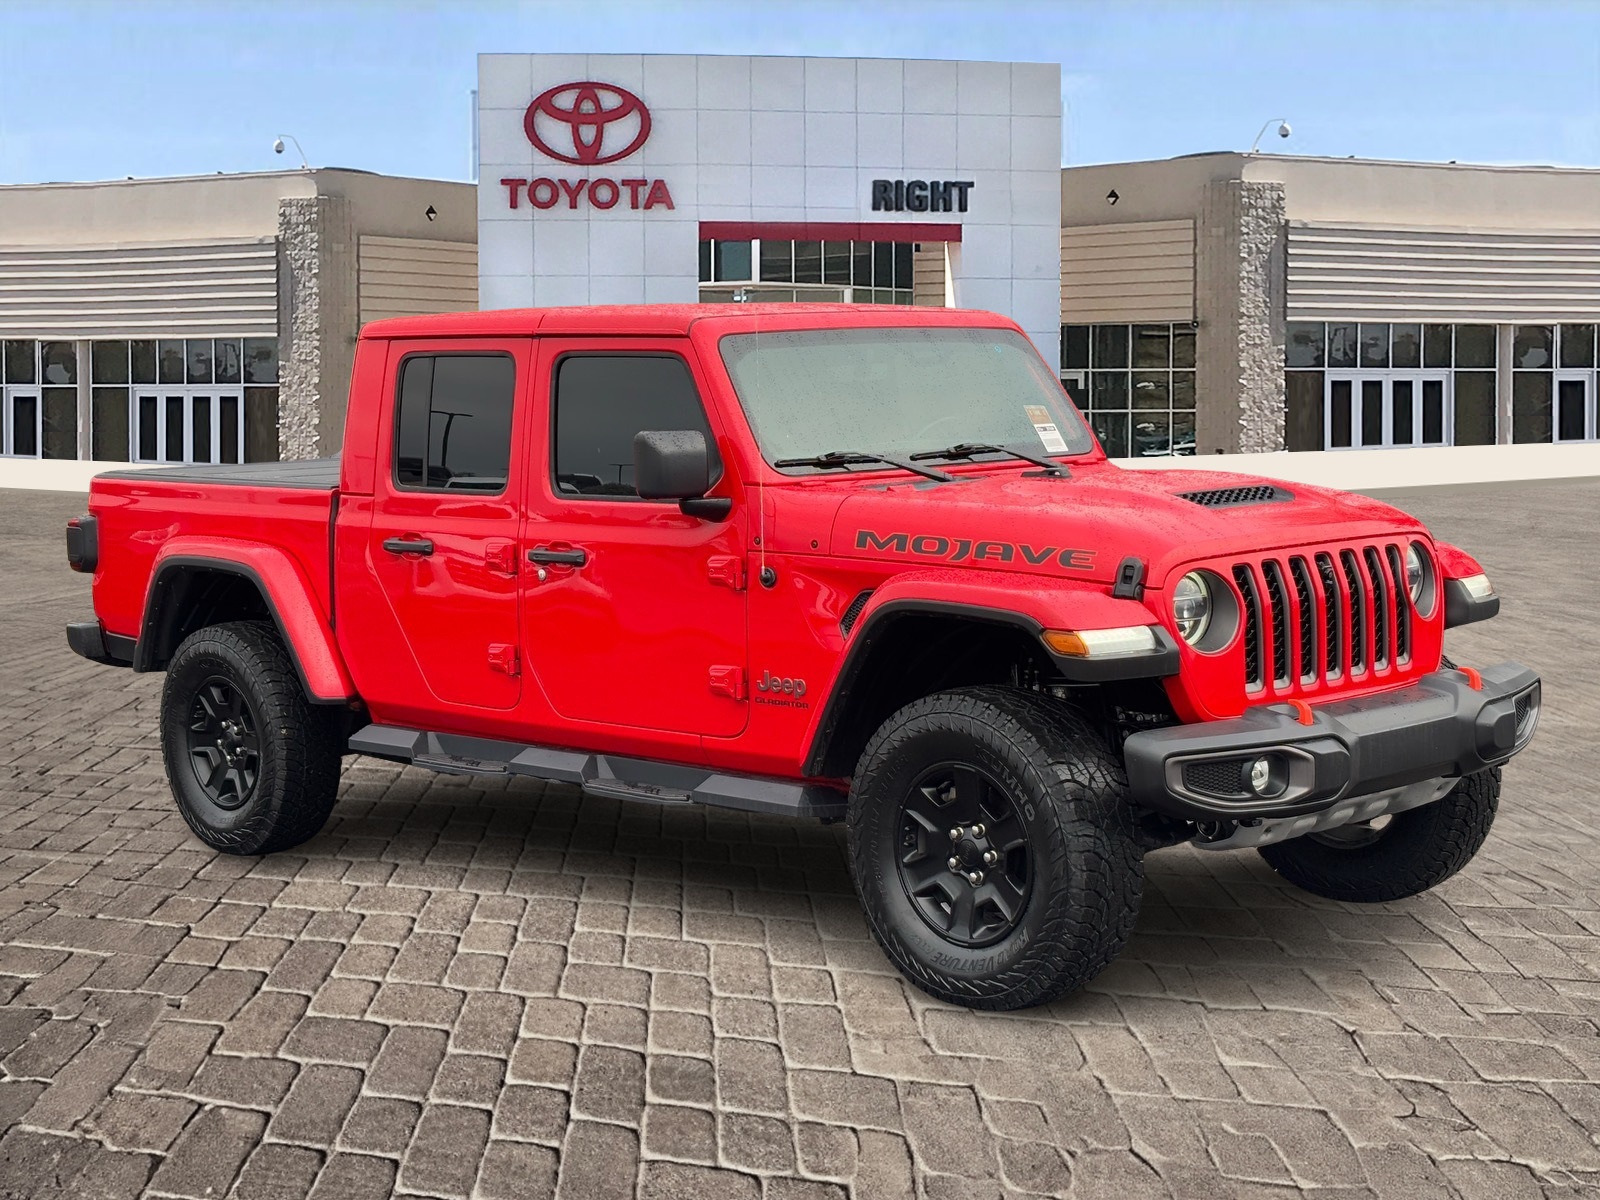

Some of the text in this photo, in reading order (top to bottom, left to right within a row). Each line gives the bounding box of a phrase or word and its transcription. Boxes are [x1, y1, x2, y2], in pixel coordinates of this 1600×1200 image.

[500, 177, 676, 210] TOYOTA
[871, 179, 975, 213] RIGHT
[854, 529, 1097, 570] MOJAVE
[756, 669, 807, 699] Jeep
[755, 696, 809, 709] GLADIATOR
[930, 951, 995, 972] VENTURE
